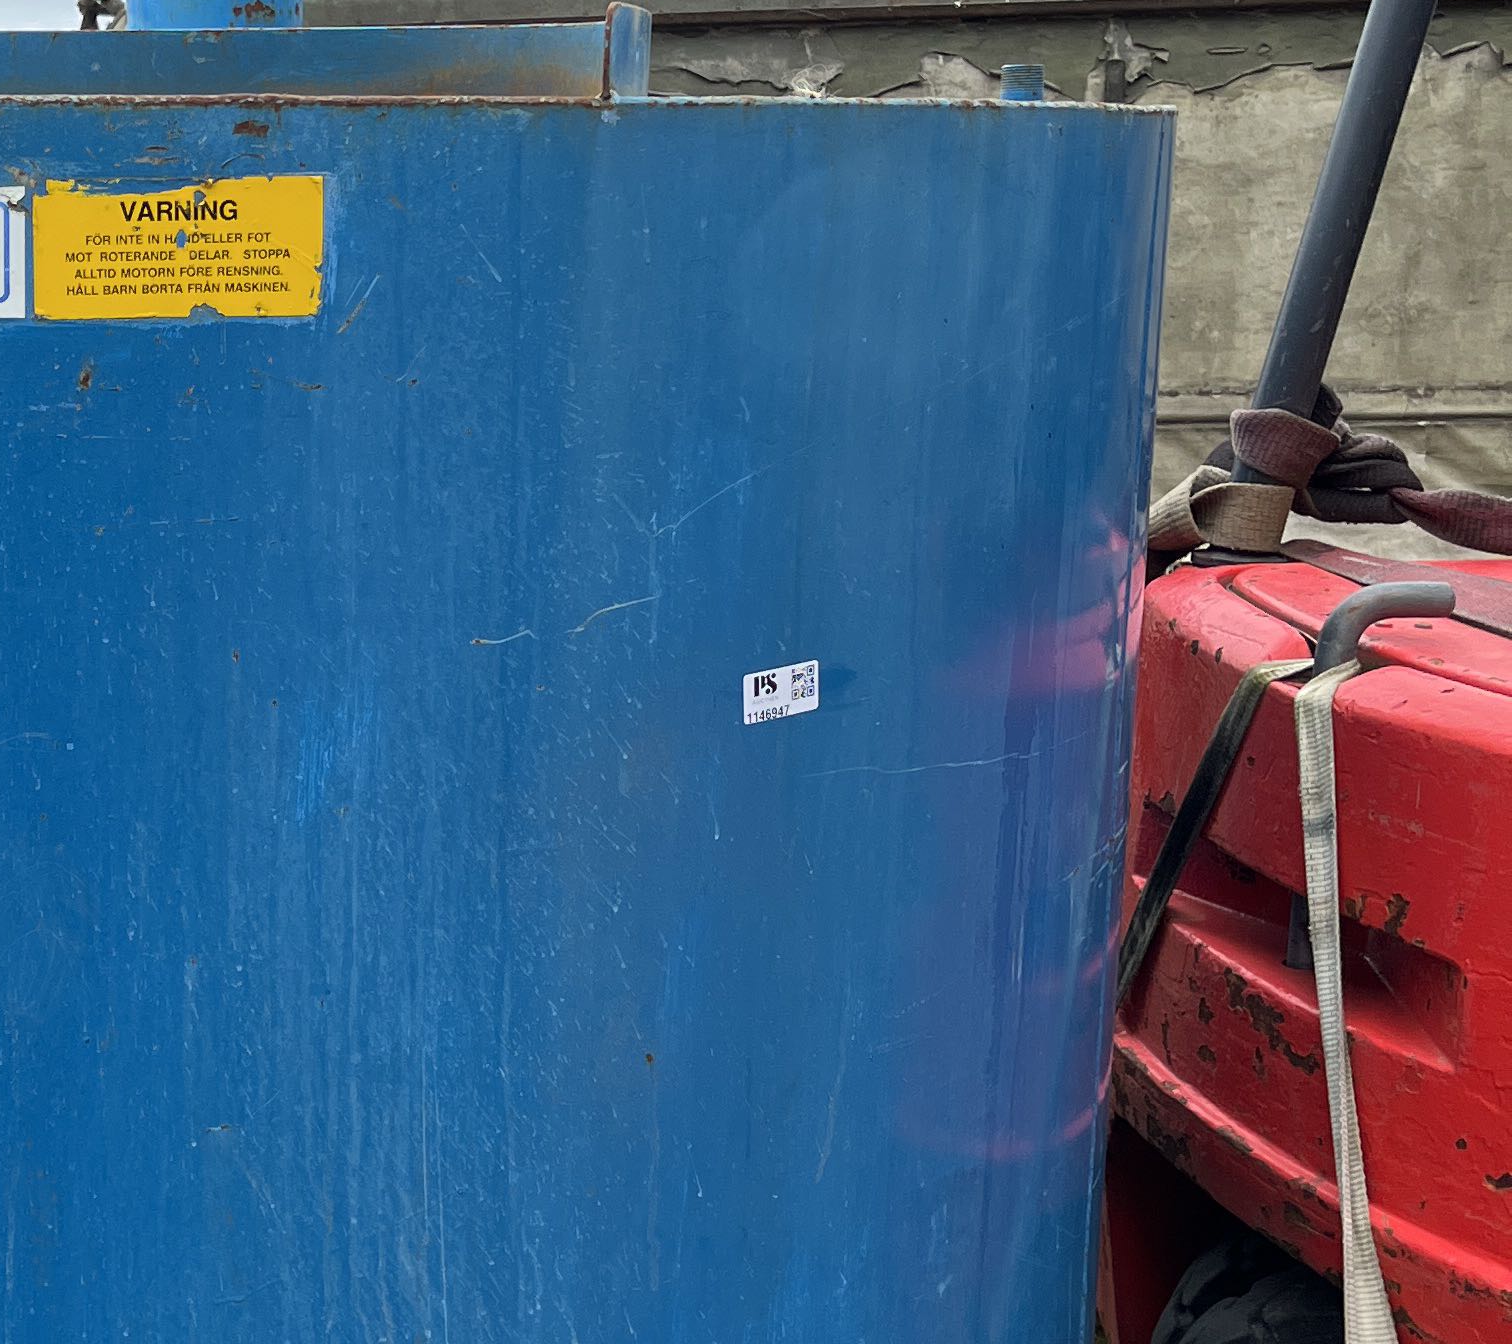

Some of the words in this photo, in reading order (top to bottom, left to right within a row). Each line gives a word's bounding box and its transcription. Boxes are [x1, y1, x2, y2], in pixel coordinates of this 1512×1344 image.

[120, 199, 238, 221] VARNING
[86, 233, 111, 246] FÖR
[116, 234, 144, 245] INTE
[148, 234, 160, 244] IN
[204, 232, 243, 244] ELLER
[247, 232, 272, 243] FOT
[65, 252, 93, 263] MOT
[100, 251, 176, 262] ROTERANDE
[243, 248, 291, 260] STOPPA
[74, 268, 117, 280] ALLTID
[120, 267, 175, 278] MOTORN
[179, 264, 213, 277] FÖRE
[66, 283, 99, 296] HÅLL
[103, 285, 137, 296] BARN
[142, 283, 184, 295] BORTA
[187, 281, 220, 293] FRÅN
[746, 704, 791, 724] 1146947
